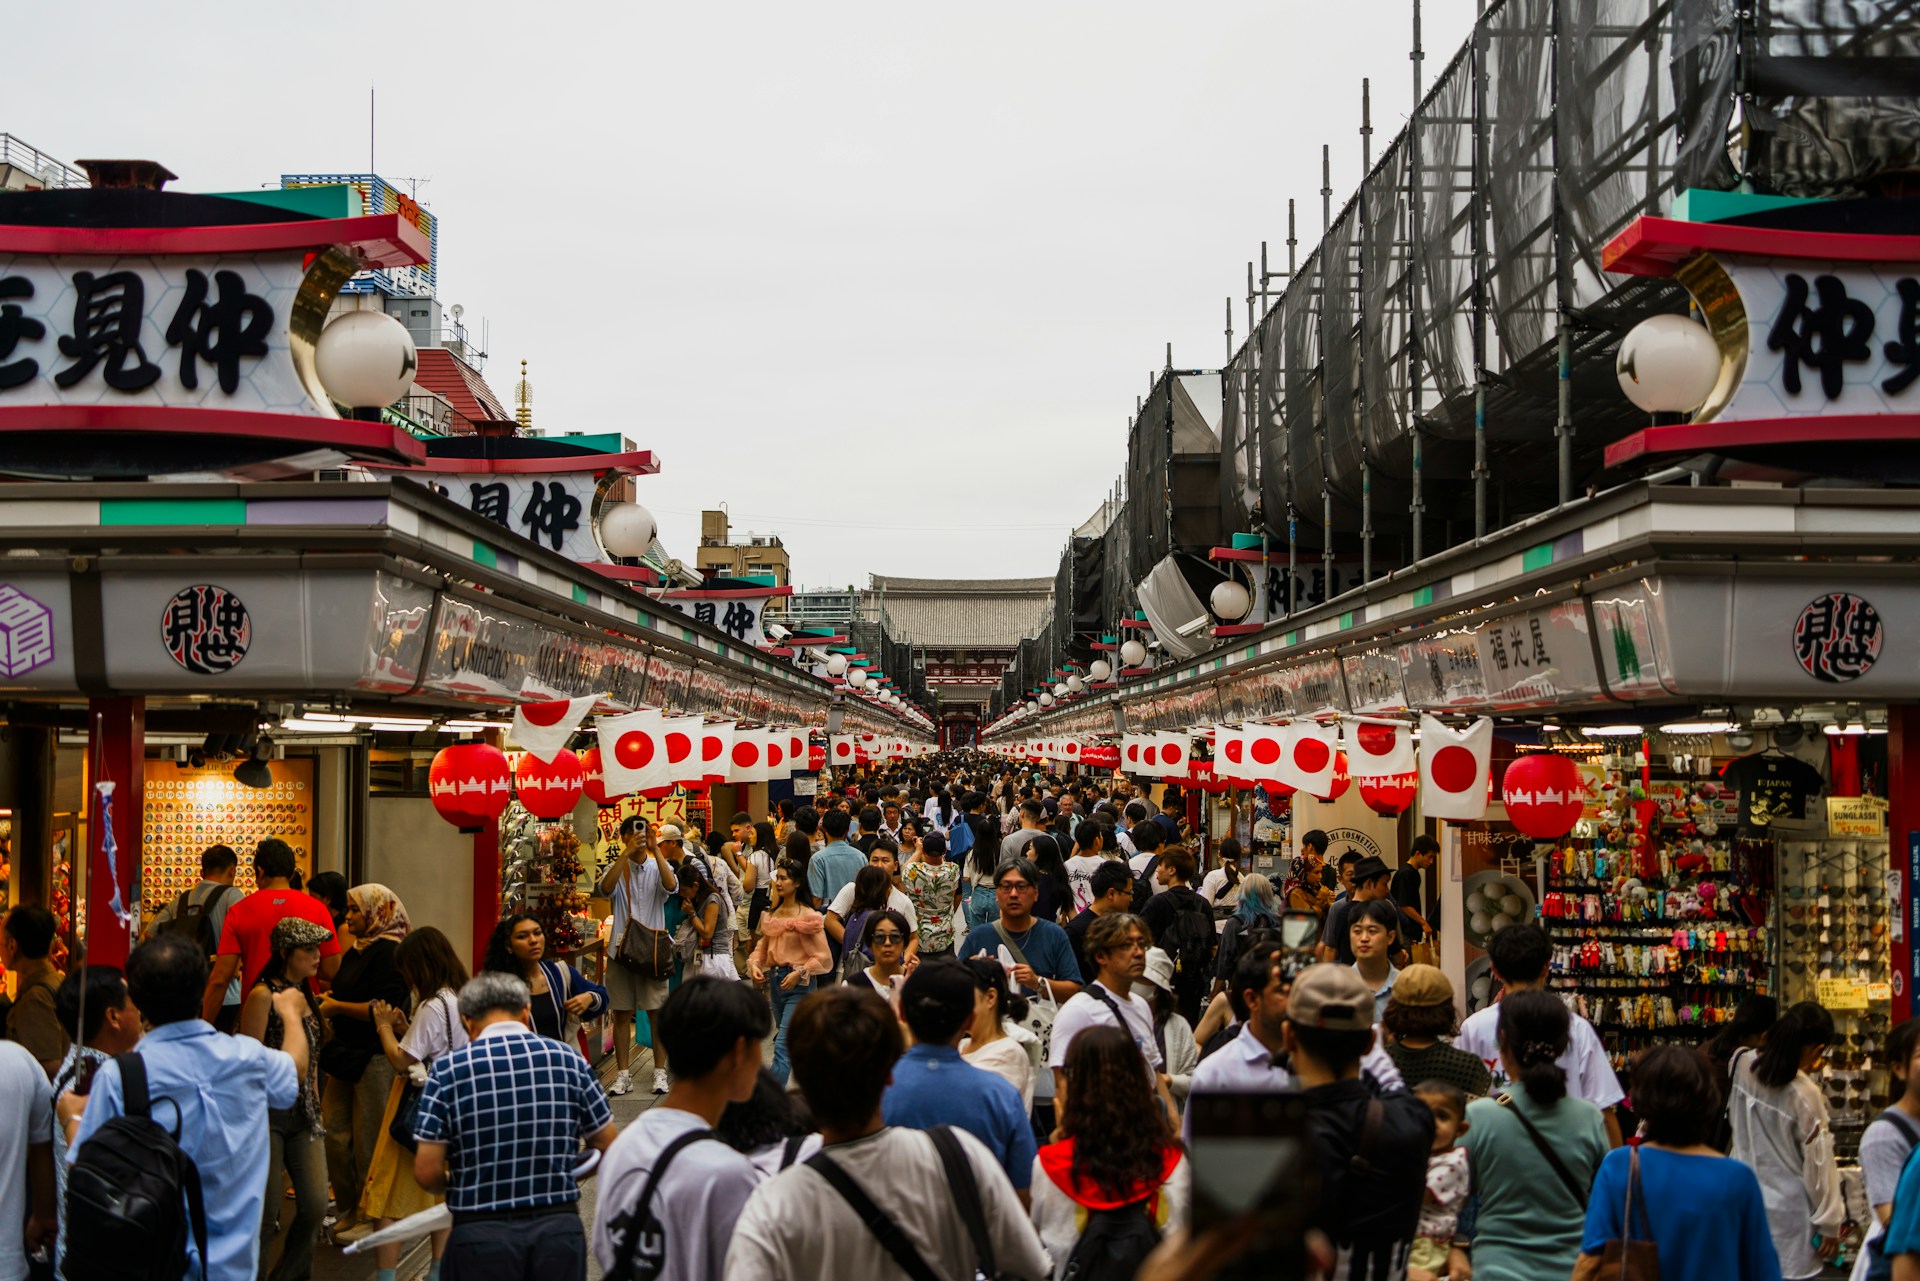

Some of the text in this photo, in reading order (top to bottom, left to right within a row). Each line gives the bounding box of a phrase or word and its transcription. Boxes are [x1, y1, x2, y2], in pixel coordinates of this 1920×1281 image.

[452, 619, 510, 680] Cosmetics
[1489, 617, 1552, 671] 福光屋
[1766, 779, 1792, 788] JAPAN
[1342, 831, 1378, 855] COSMETICS
[1464, 830, 1532, 846] 甘味みつや
